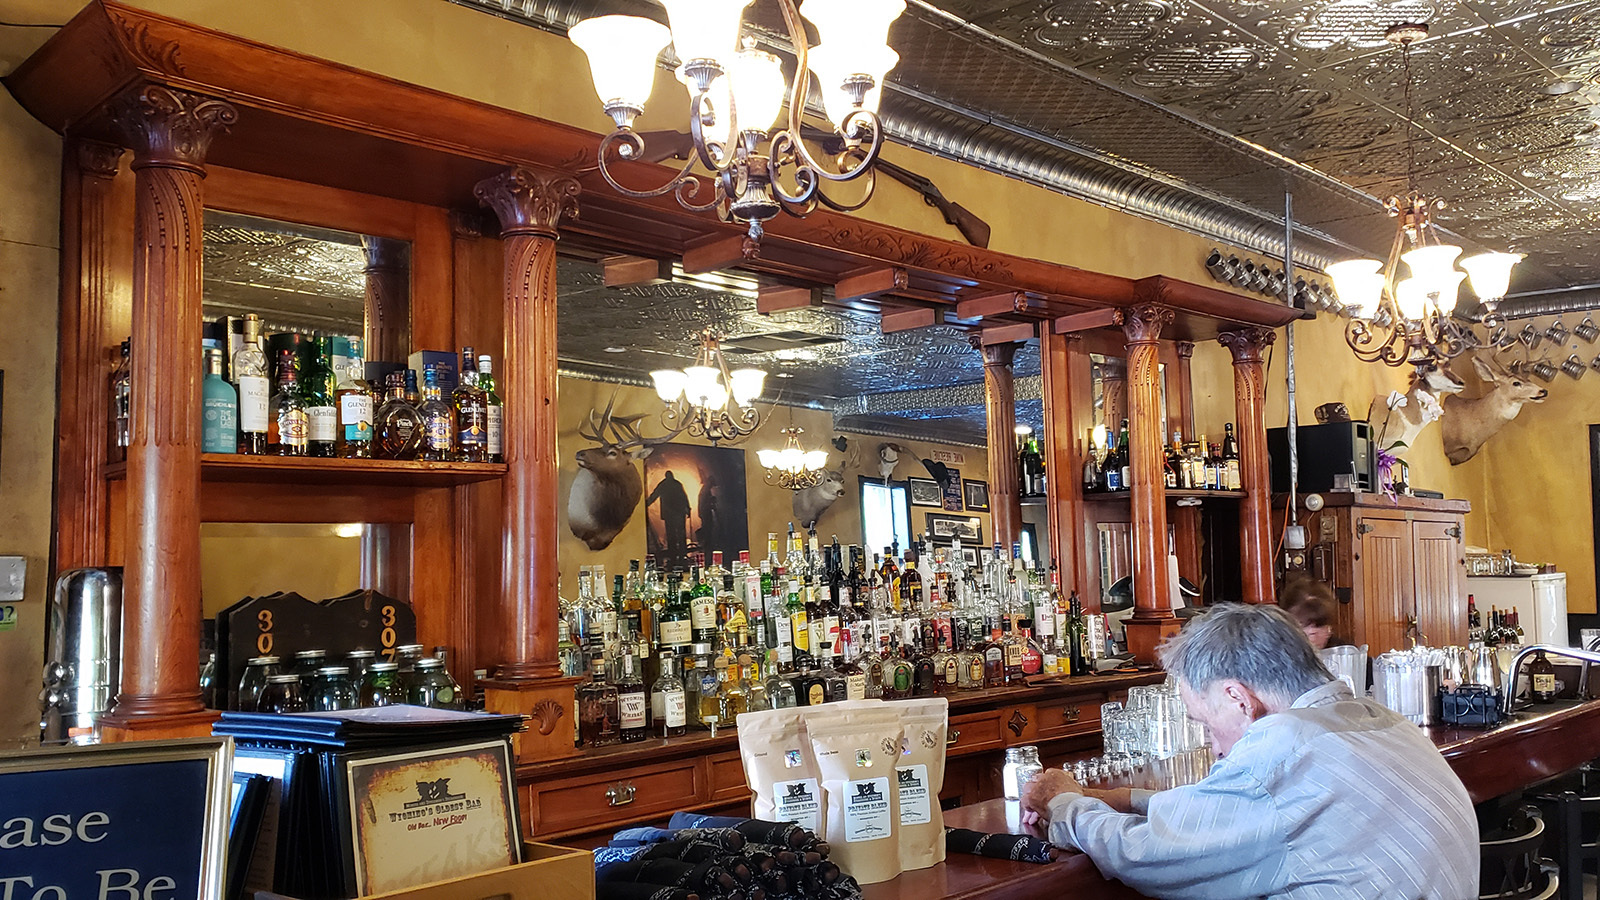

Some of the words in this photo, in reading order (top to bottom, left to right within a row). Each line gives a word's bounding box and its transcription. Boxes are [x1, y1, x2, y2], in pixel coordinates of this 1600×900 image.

[693, 598, 714, 607] JAMESO
[0, 811, 110, 849] ase
[96, 868, 176, 900] Be
